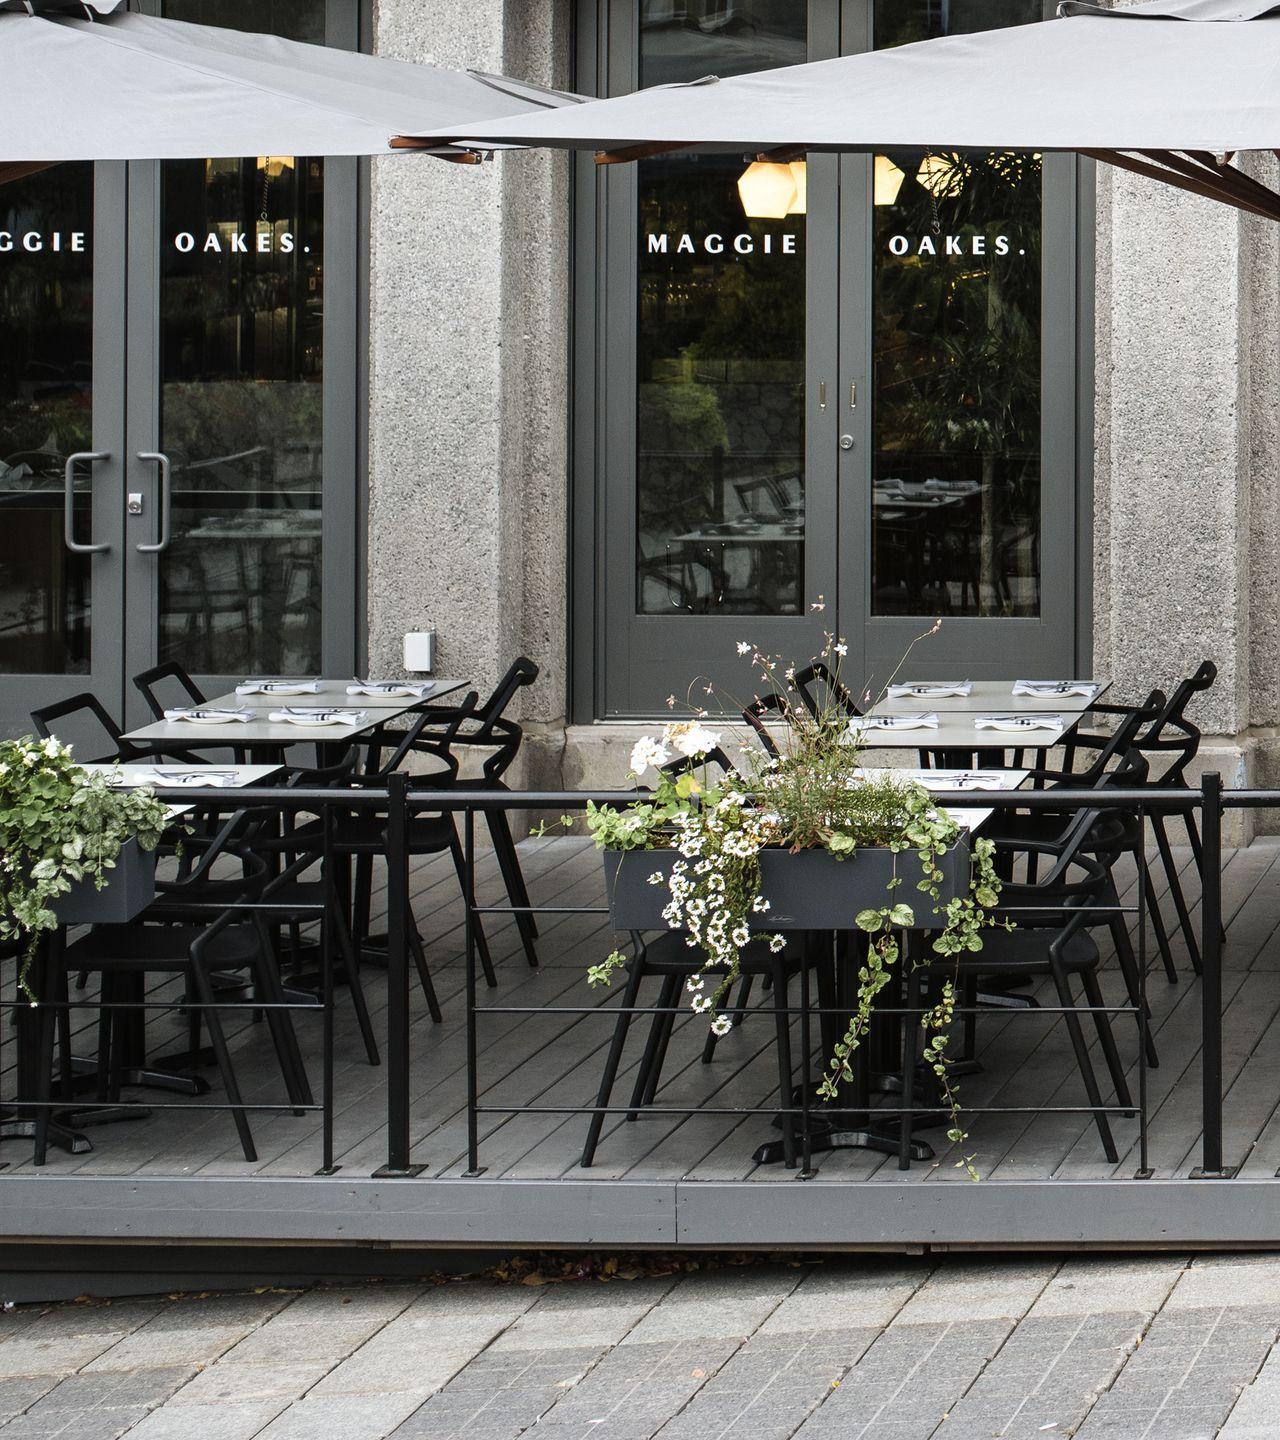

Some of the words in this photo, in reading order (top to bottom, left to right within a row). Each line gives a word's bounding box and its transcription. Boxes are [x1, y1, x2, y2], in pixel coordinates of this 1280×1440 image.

[0, 231, 86, 252] GGIE
[174, 232, 310, 253] OAKES.
[648, 233, 796, 254] MAGGIE
[888, 235, 1025, 256] OAKES.
